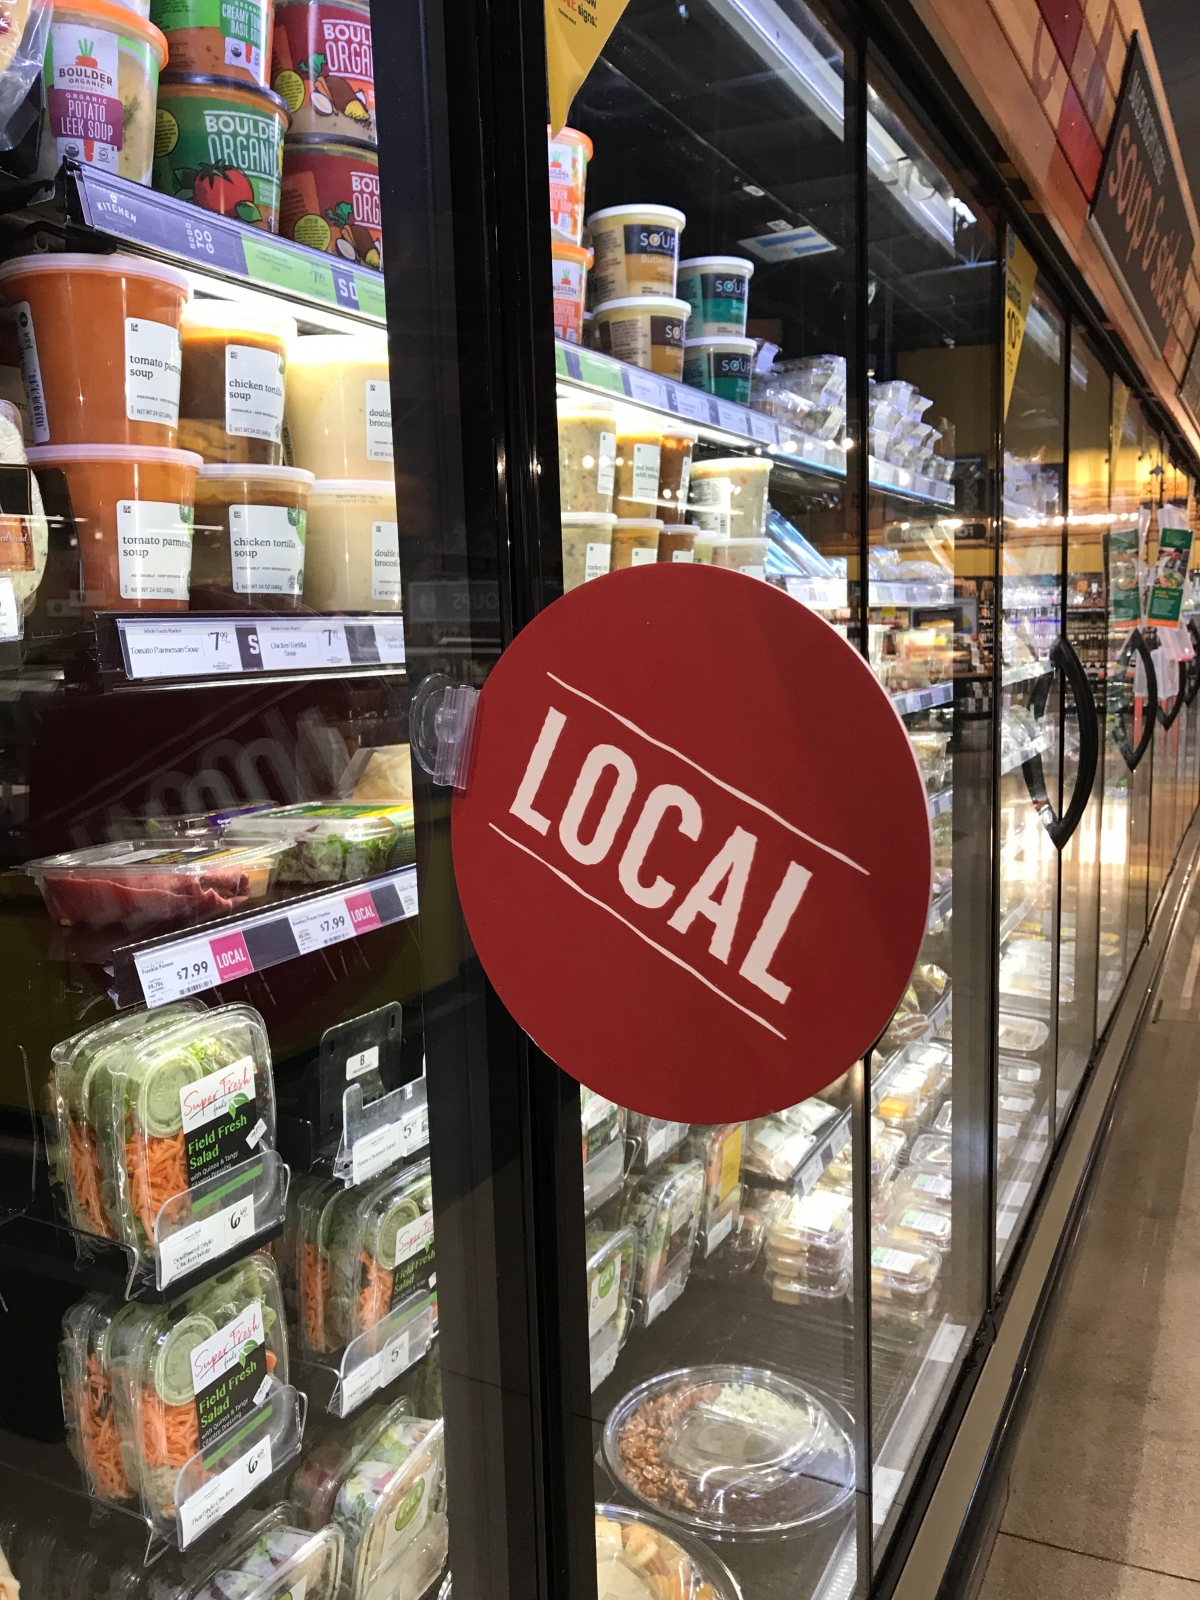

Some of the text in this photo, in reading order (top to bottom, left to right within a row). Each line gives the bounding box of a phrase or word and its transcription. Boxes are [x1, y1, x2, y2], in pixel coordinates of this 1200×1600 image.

[222, 4, 249, 23] CREAMY
[231, 20, 248, 38] BASIL
[323, 24, 371, 46] BOUL
[59, 68, 113, 87] BOULDER
[68, 78, 105, 90] ORGANIC
[65, 93, 107, 104] ORGANIC
[68, 100, 106, 122] POTATO
[60, 117, 113, 142] LEEK SOUP
[96, 201, 137, 224] KITCHEN
[194, 229, 205, 249] TO
[203, 230, 215, 255] GO
[553, 284, 577, 295] BOULDER
[130, 355, 163, 368] tomato
[130, 368, 153, 380] soup
[229, 378, 263, 391] chicken
[229, 391, 251, 401] soup
[369, 419, 392, 428] brocco
[123, 536, 160, 545] tomato
[234, 537, 296, 549] chicken tortilla
[123, 549, 149, 559] soup
[234, 550, 258, 559] soup
[375, 549, 397, 558] double
[130, 645, 200, 655] Tomato Parmesan Soup
[509, 706, 813, 1004] LOCAL
[320, 915, 345, 932] $7.99
[350, 905, 375, 923] LOCAL
[141, 961, 174, 975] Frankie Paneer
[216, 948, 246, 969] LOCAL
[176, 960, 208, 980] $7.99
[183, 1067, 252, 1117] Super Fresh
[213, 1100, 227, 1116] foods
[188, 1114, 247, 1155] Field Fresh
[189, 1143, 219, 1170] Salad
[190, 1151, 239, 1181] with Quinoa & Tangy
[398, 1230, 420, 1253] Super
[173, 1238, 214, 1265] Southwest Style
[176, 1252, 197, 1270] Chicken
[395, 1249, 436, 1283] Field Fresh
[394, 1273, 415, 1294] Salad
[195, 1313, 261, 1377] Super Fresh
[223, 1351, 237, 1369] foods
[199, 1361, 257, 1414] Field Fresh
[201, 1396, 230, 1428] Salad
[201, 1427, 213, 1440] with
[213, 1413, 230, 1430] Quinoa
[235, 1397, 249, 1412] Tangy
[202, 1411, 242, 1448] Cilantro Dressing
[202, 1503, 215, 1515] Style
[215, 1487, 235, 1506] Chicken
[206, 1506, 221, 1520] Wrap
